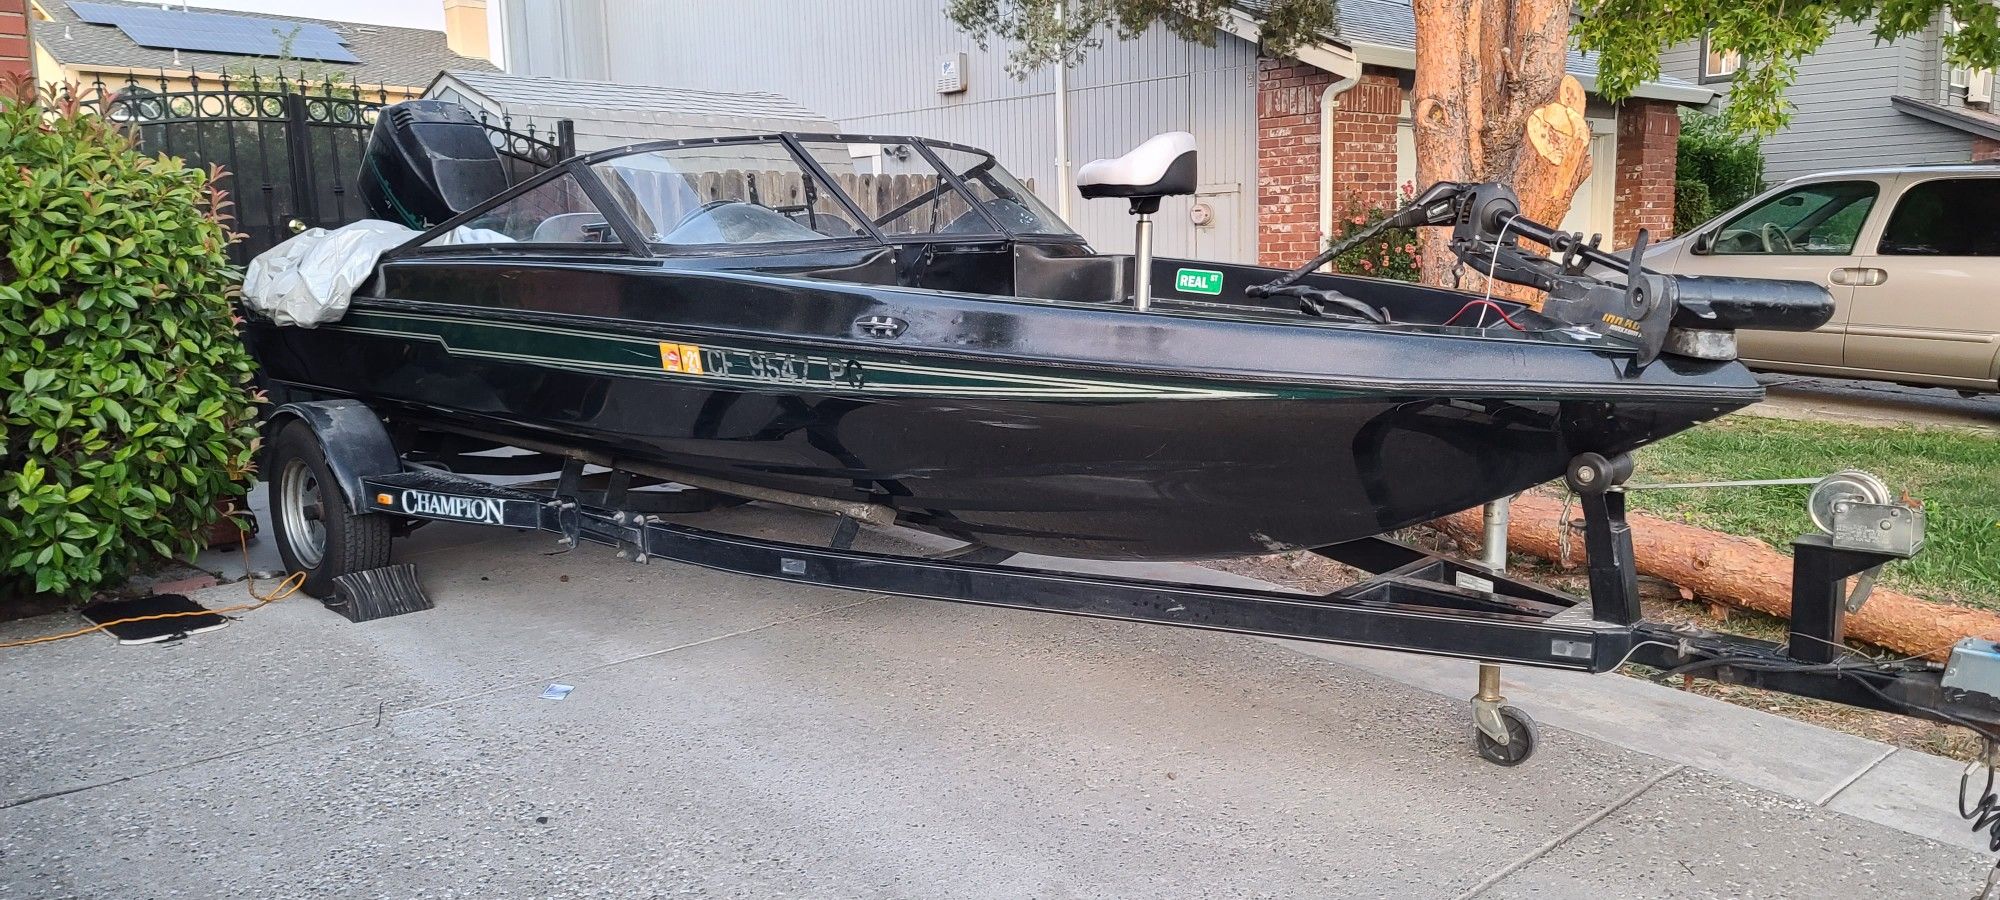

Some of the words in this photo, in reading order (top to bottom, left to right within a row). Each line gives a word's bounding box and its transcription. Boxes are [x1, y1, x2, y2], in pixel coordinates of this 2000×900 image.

[1180, 275, 1208, 288] REAL
[686, 350, 700, 369] 21
[707, 350, 734, 378] CF
[750, 351, 809, 386] 9547
[401, 489, 507, 525] CHAMPION
